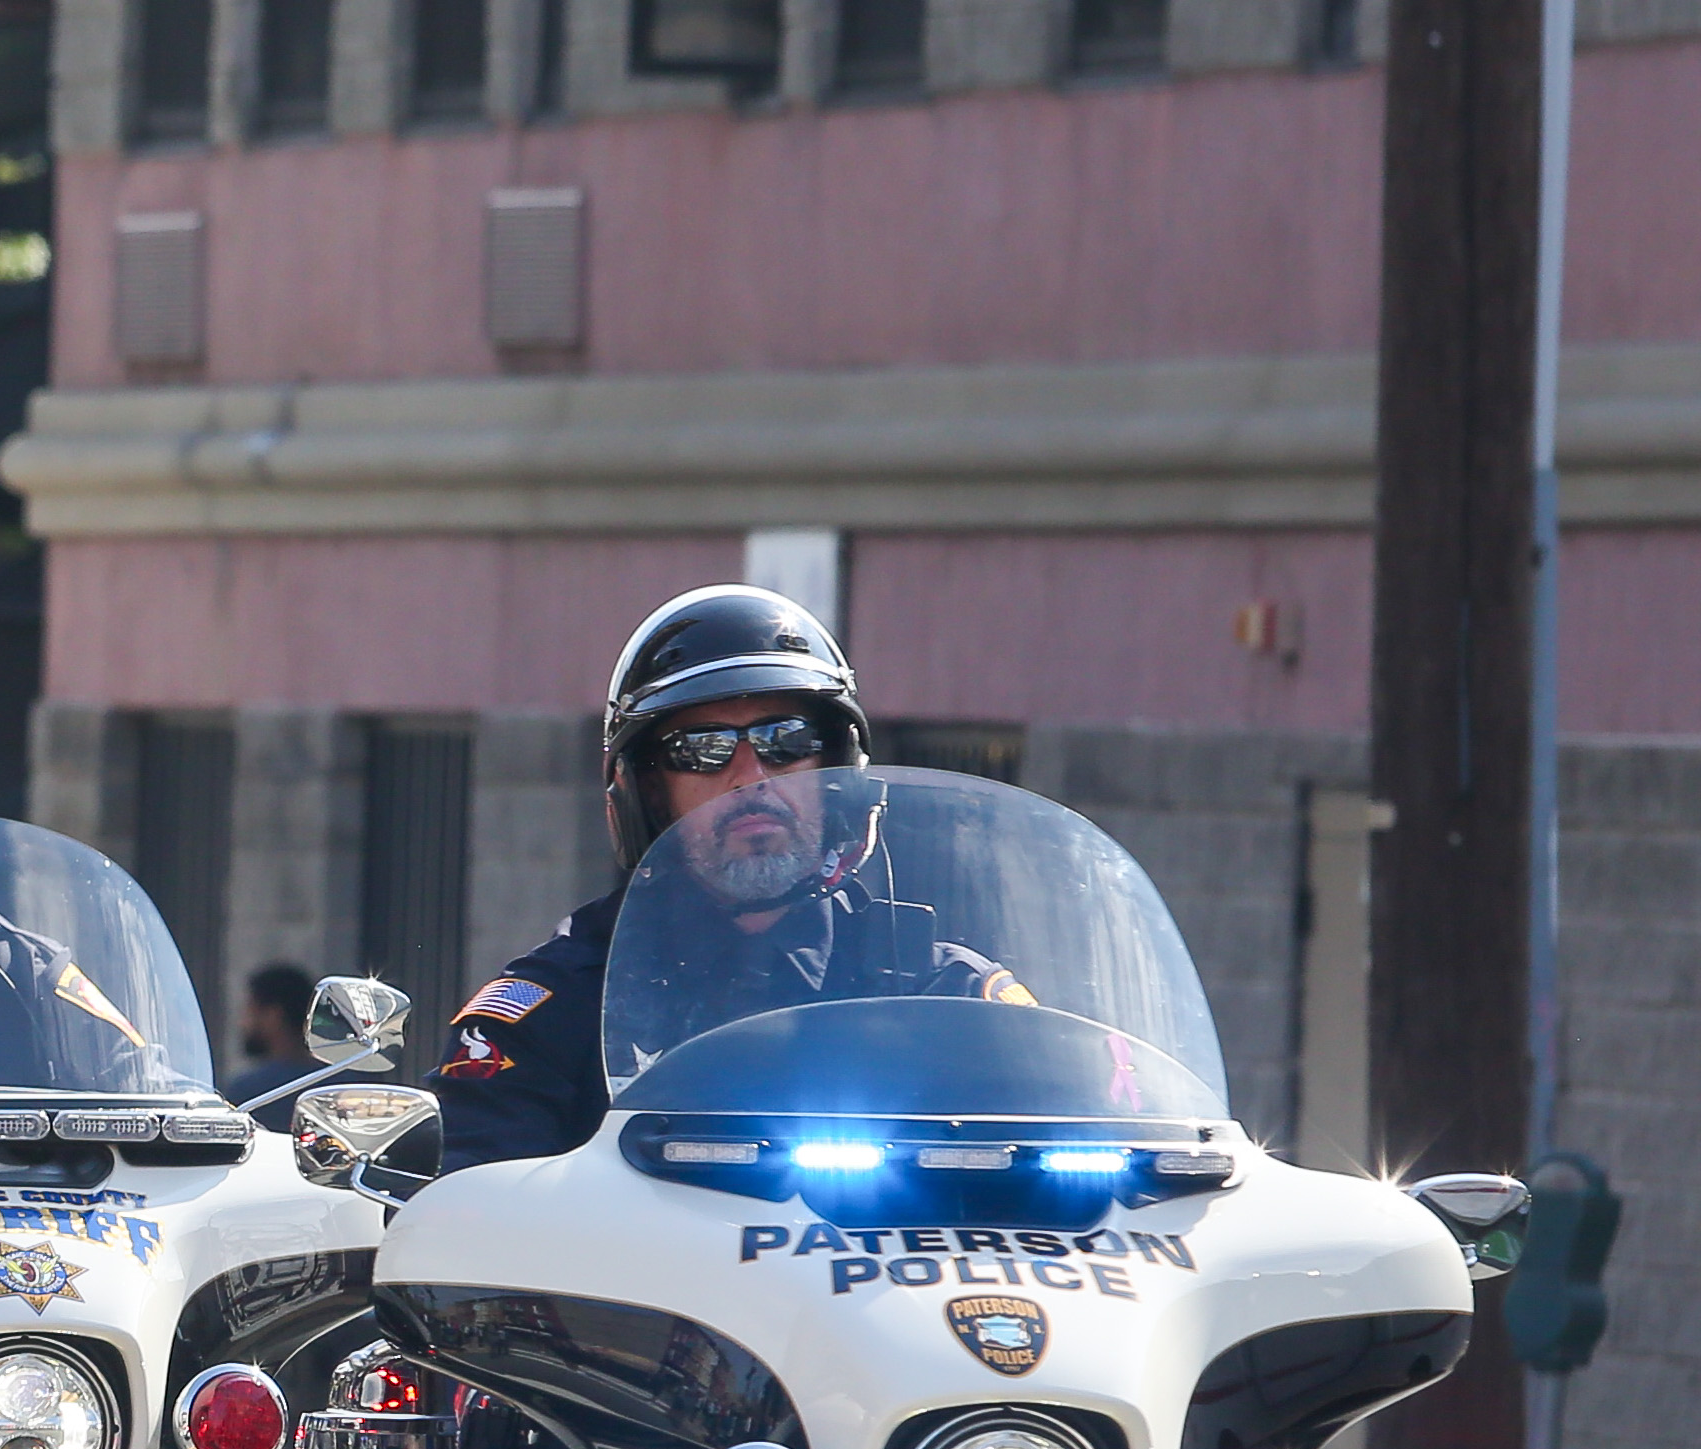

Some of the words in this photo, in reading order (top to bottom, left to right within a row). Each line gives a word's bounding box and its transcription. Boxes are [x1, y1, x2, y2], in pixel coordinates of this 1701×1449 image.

[19, 1190, 147, 1208] COUNTY
[739, 1223, 1198, 1272] PATERSON
[830, 1256, 1142, 1301] POLICE
[952, 1297, 1039, 1319] PATERSON
[981, 1348, 1037, 1365] POLICE
